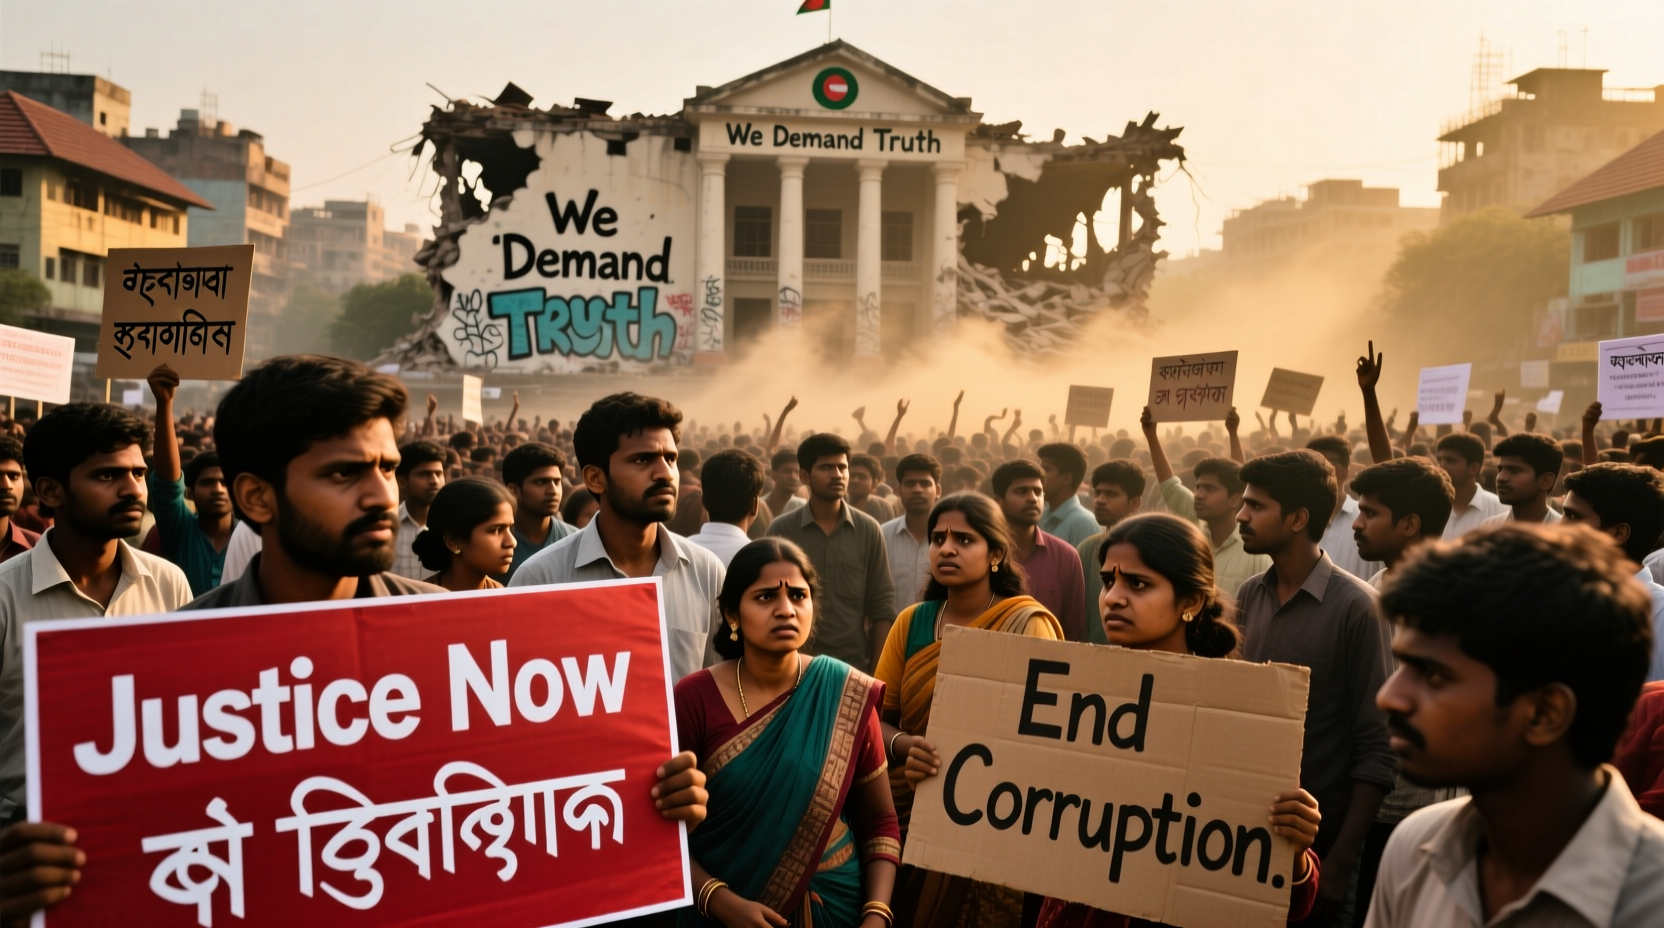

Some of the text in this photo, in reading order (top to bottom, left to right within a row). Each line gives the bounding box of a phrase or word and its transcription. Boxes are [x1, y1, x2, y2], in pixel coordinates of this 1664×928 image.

[726, 122, 942, 155] We Demand Truth
[545, 189, 618, 238] We
[73, 639, 632, 776] Justice Now
[1018, 658, 1155, 753] End
[942, 743, 1285, 889] Corruption.
